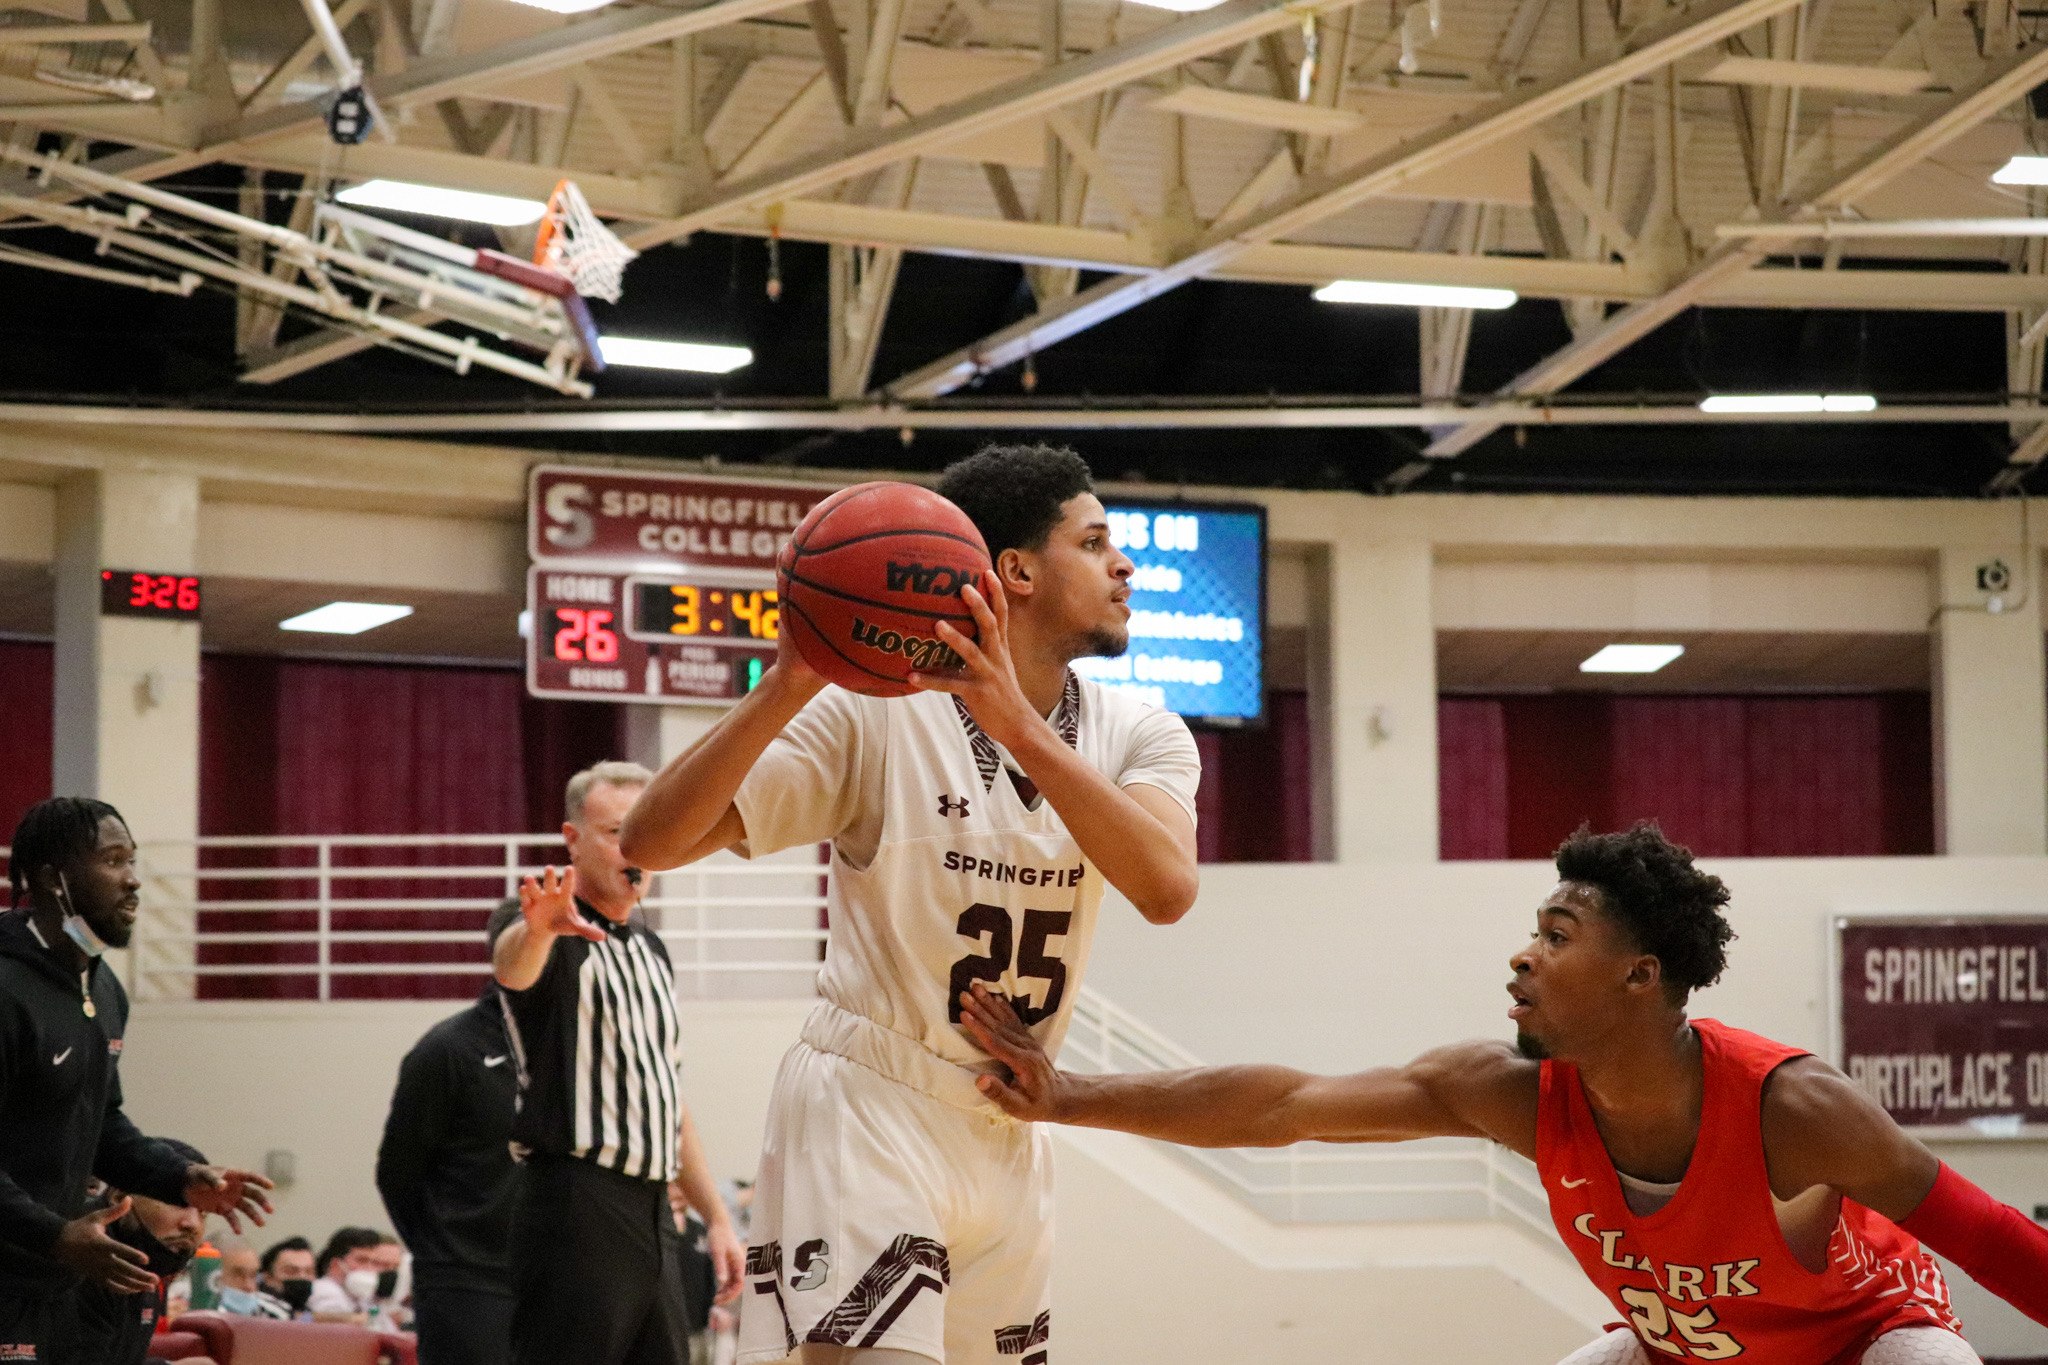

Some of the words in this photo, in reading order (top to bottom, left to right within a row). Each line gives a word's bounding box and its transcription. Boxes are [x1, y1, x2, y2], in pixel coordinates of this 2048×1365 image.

[601, 489, 814, 529] SPRINGFIEL
[129, 573, 200, 611] 3:26
[547, 577, 615, 604] HOME
[554, 607, 619, 663] 26
[947, 902, 1072, 1026] 25
[1864, 944, 2048, 1003] SPRINGFIEL
[1572, 1212, 1761, 1303] CLARK
[1618, 1284, 1747, 1361] 25
